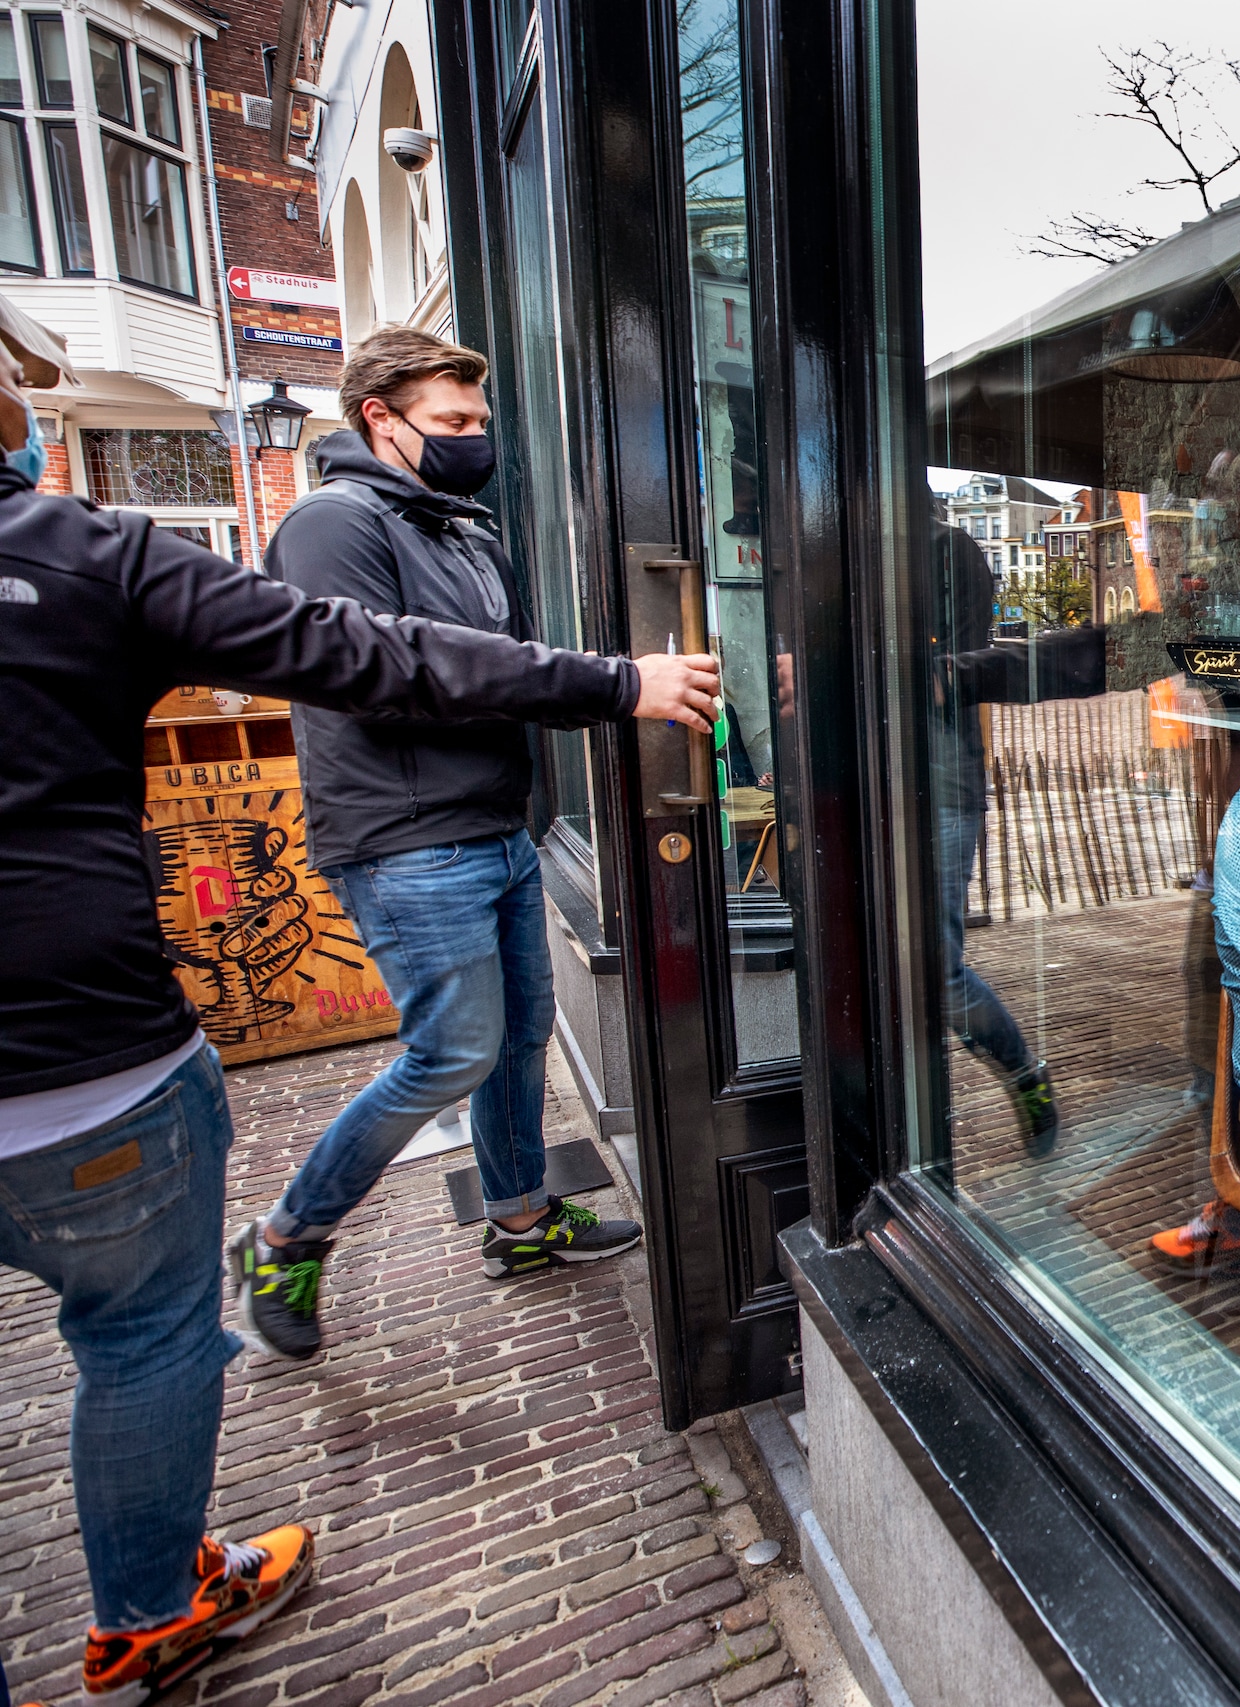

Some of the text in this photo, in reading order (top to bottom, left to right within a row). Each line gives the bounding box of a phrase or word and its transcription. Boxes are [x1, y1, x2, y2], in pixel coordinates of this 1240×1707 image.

[266, 275, 318, 288] Stadhuis
[254, 330, 332, 347] SCHOUTENSTRAAT
[1194, 651, 1237, 673] Spirit
[164, 762, 261, 787] UBICA
[312, 989, 391, 1017] Duve
